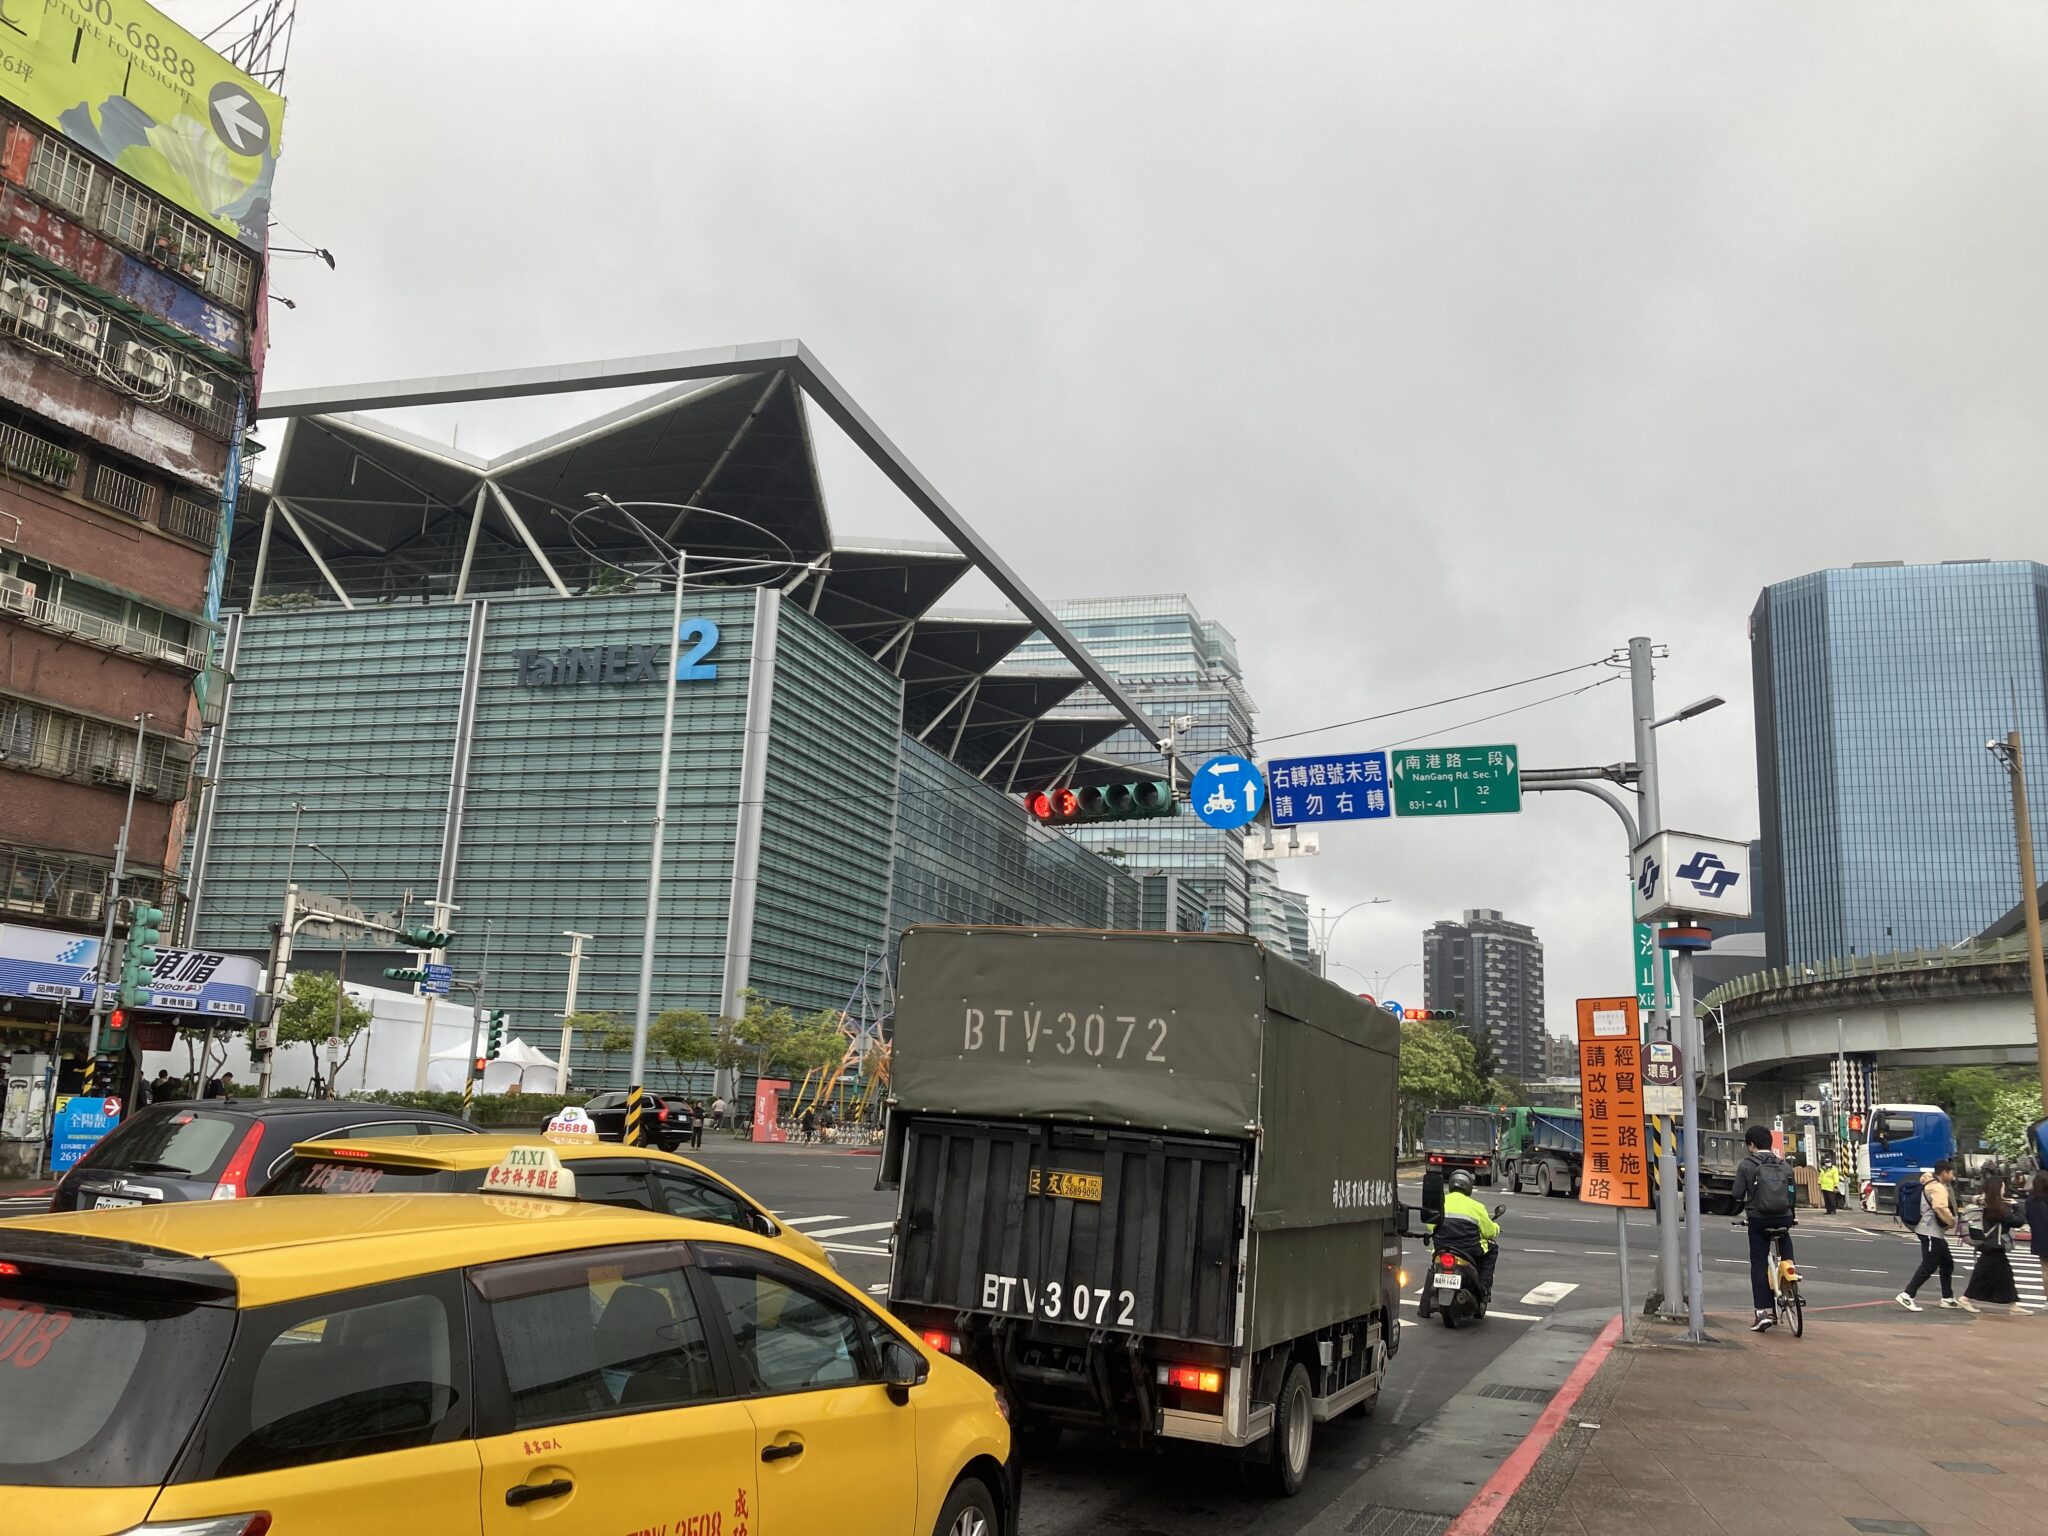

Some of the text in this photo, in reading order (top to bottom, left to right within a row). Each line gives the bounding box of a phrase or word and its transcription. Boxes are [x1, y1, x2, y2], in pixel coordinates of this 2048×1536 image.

[0, 54, 34, 83] 6坪
[108, 35, 193, 104] FORESIGHT
[512, 616, 719, 686] TaiNEX 2
[1272, 759, 1382, 789] 右轉燈號未亮
[1405, 751, 1504, 770] 南港路一段
[1412, 772, 1453, 782] NanGang
[1456, 771, 1470, 780] Rd.
[1473, 770, 1491, 779] Sec.
[1476, 786, 1490, 795] 32
[1275, 788, 1385, 818] 請勿右轉
[964, 1008, 1167, 1063] BTV-3072
[549, 1122, 588, 1133] 55688
[1586, 1045, 1611, 1200] 請改道三重路
[1614, 1045, 1641, 1201] 經貿二路施工
[511, 1150, 546, 1166] TAXI
